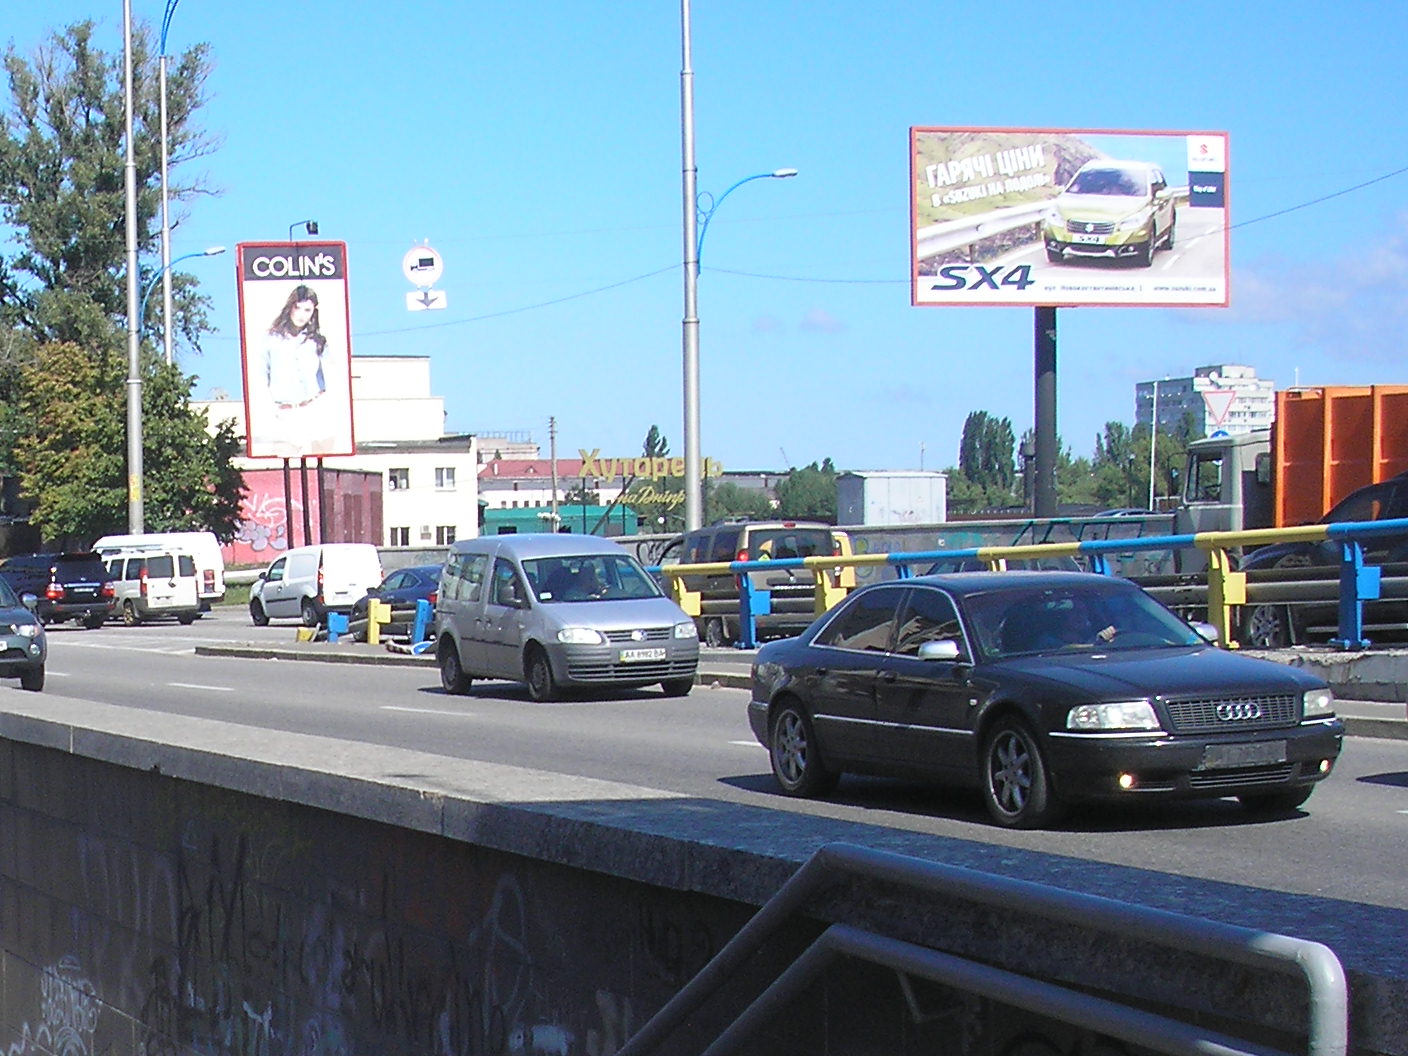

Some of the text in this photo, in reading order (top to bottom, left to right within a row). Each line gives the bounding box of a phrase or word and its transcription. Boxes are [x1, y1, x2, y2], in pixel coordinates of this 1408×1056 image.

[926, 144, 1045, 188] ГАРЯЧІ ЦІНИ
[252, 252, 336, 277] COLIN'S
[931, 264, 1036, 291] SX4
